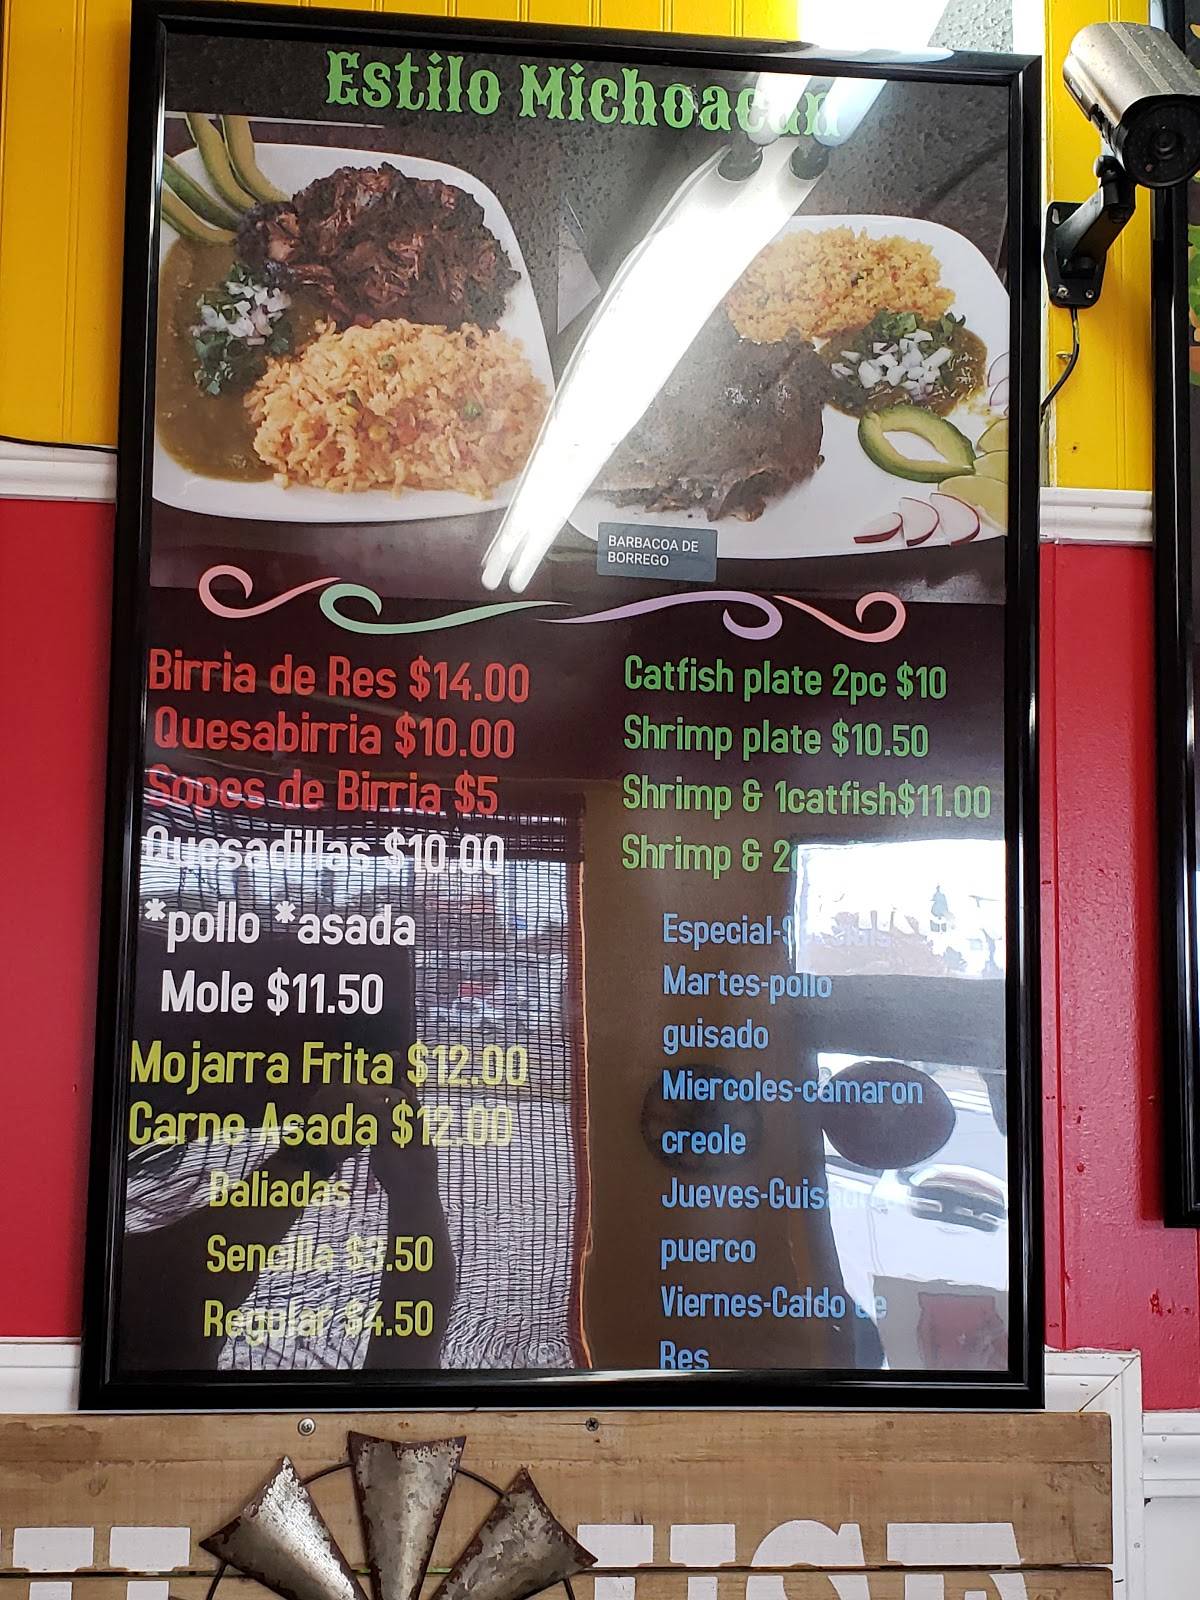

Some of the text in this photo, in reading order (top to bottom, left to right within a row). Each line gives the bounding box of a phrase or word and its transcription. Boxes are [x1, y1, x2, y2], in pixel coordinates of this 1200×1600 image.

[326, 50, 501, 116] Estilo
[607, 551, 670, 567] BORREGO
[608, 534, 699, 553] BARBACOA DE
[148, 648, 530, 703] Birria de Res $14.00
[624, 654, 947, 705] Catfish plate 2pc $10
[154, 705, 516, 759] Quesabirria $10.00
[623, 714, 930, 761] Shrimp plate $10.50
[147, 763, 499, 820] Sopes de Birria $5
[622, 774, 992, 820] Shrimp & 1catfish$11.00
[146, 824, 505, 876] Quesadillas $10.00
[621, 834, 731, 880] Shrimp
[741, 838, 763, 873] &
[161, 966, 384, 1016] Mole $11.50
[662, 965, 833, 1005] Martes-pollo
[662, 1018, 769, 1056] guisado
[129, 1039, 529, 1095] Mojarra Frita $12.00
[662, 1069, 923, 1105] Miercoles-camaron
[128, 1098, 513, 1149] Carne Asada $12.00
[661, 1124, 746, 1155] creole
[209, 1170, 351, 1209] Baliadas
[205, 1233, 434, 1274] Sencilla $3.50
[661, 1238, 756, 1271] puerco
[203, 1298, 434, 1346] Regular $4.50
[661, 1284, 846, 1320] Viernes-Caldo
[660, 1340, 710, 1370] Res
